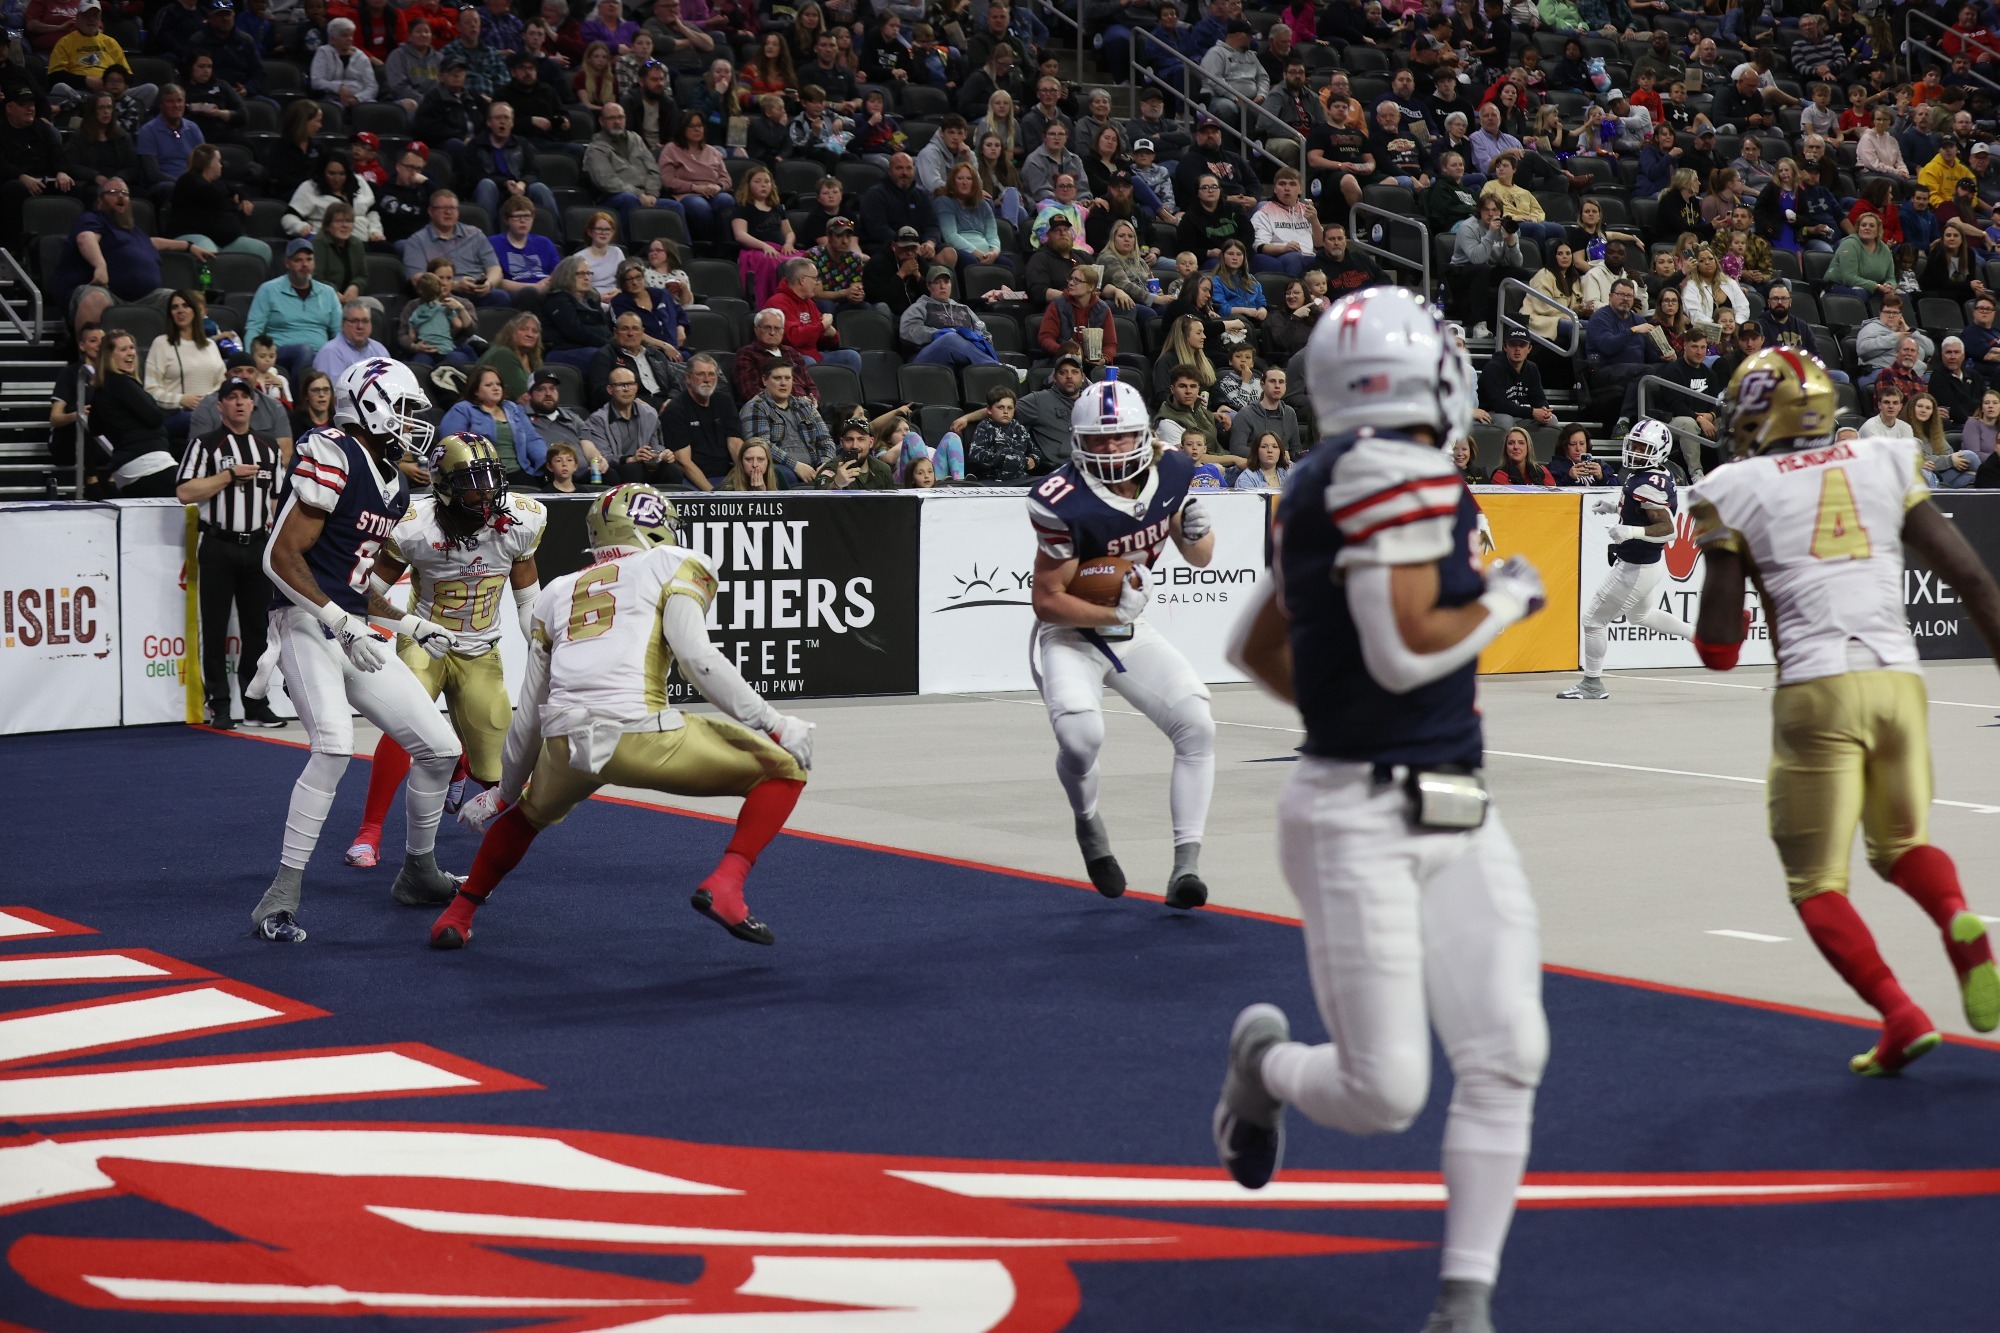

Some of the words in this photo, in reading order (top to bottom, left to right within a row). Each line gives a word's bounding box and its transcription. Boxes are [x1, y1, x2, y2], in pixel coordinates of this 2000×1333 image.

[257, 470, 272, 480] 26
[1648, 475, 1666, 489] 41
[1038, 475, 1075, 505] 81
[677, 503, 705, 517] EAST
[710, 503, 744, 517] SIOUX
[748, 502, 783, 516] FALLS
[1809, 466, 1873, 560] 4
[1107, 514, 1170, 556] STORM
[1173, 567, 1256, 586] Brown
[430, 573, 507, 632] 20
[567, 563, 620, 641] 6
[1157, 592, 1229, 604] SALONS
[1904, 619, 1959, 638] SALON
[146, 659, 176, 678] deli
[773, 680, 804, 693] PKWY
